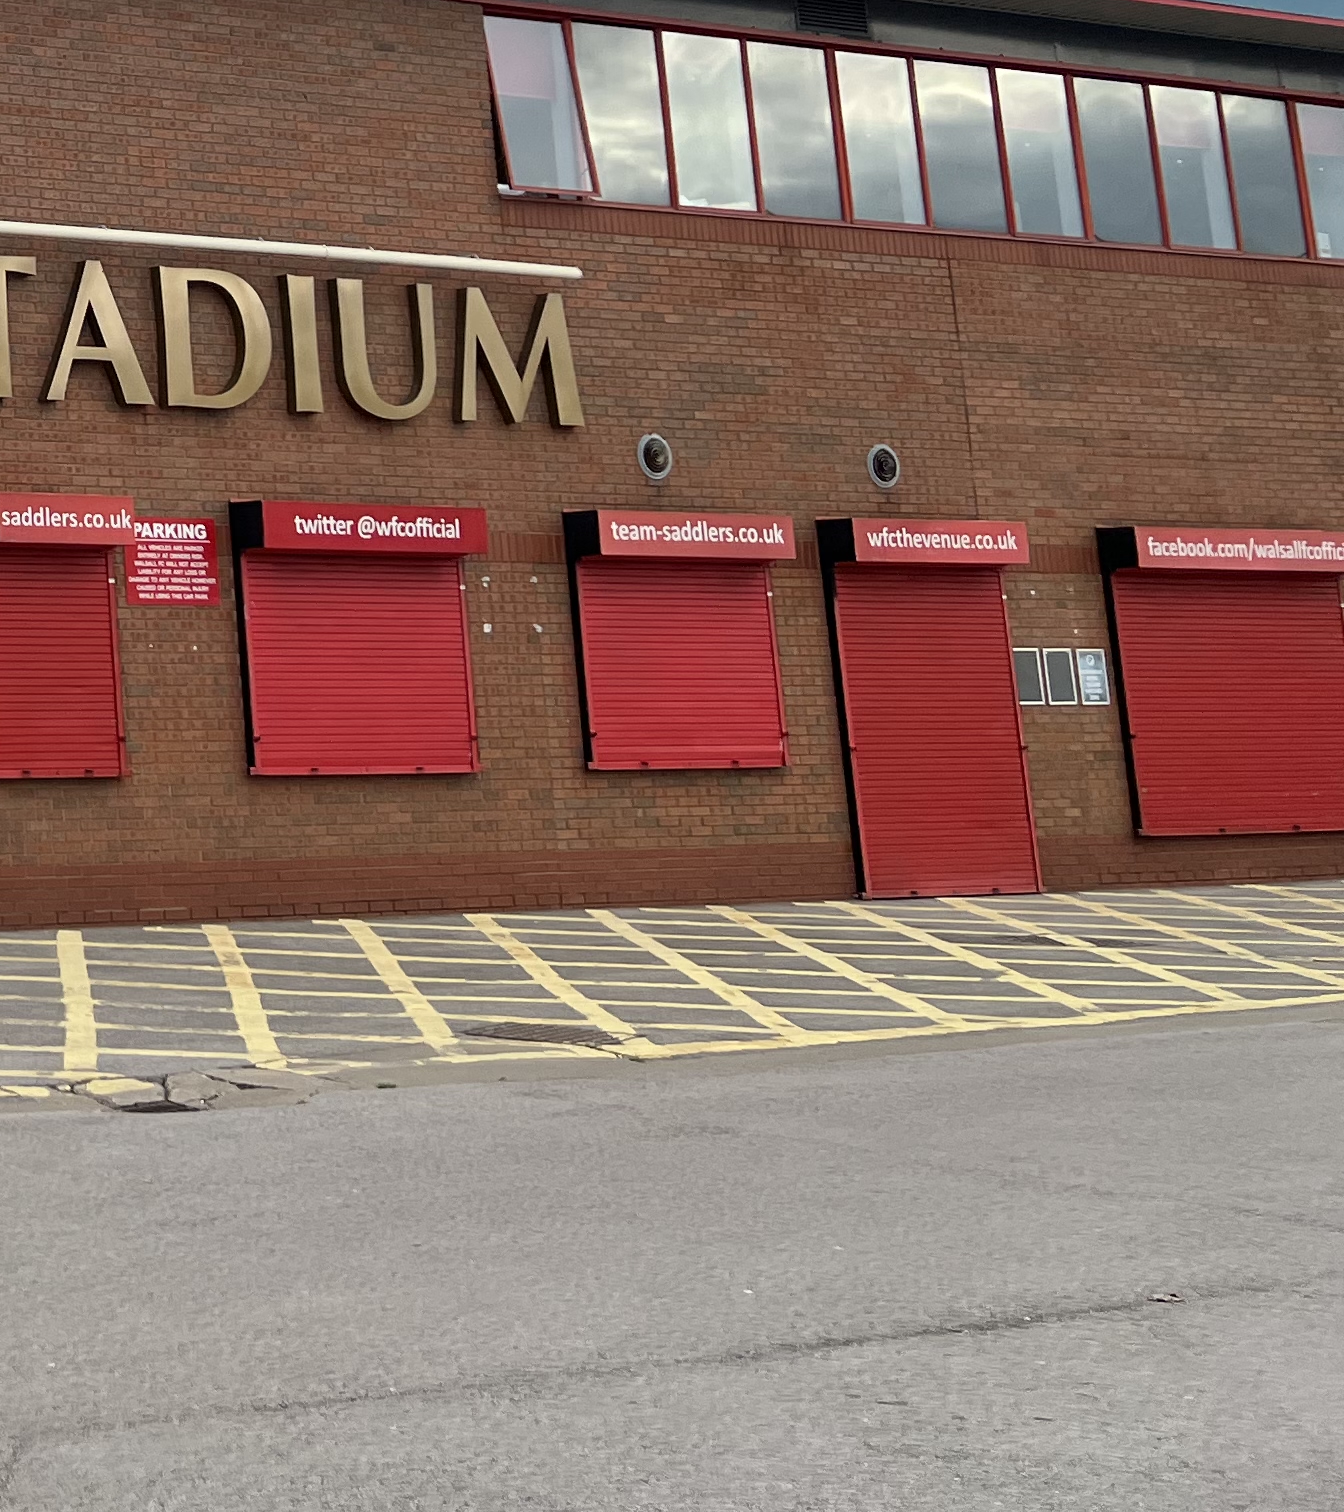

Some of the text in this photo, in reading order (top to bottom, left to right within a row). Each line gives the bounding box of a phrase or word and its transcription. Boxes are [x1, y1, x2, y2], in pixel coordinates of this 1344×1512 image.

[1, 506, 133, 529] saddlers.co.uk
[294, 515, 461, 539] twitter @wfcofficial
[133, 522, 207, 540] PARKING
[610, 520, 785, 545] team-saddlers.co.uk
[866, 526, 1018, 550] wfcthevenue.co.uk
